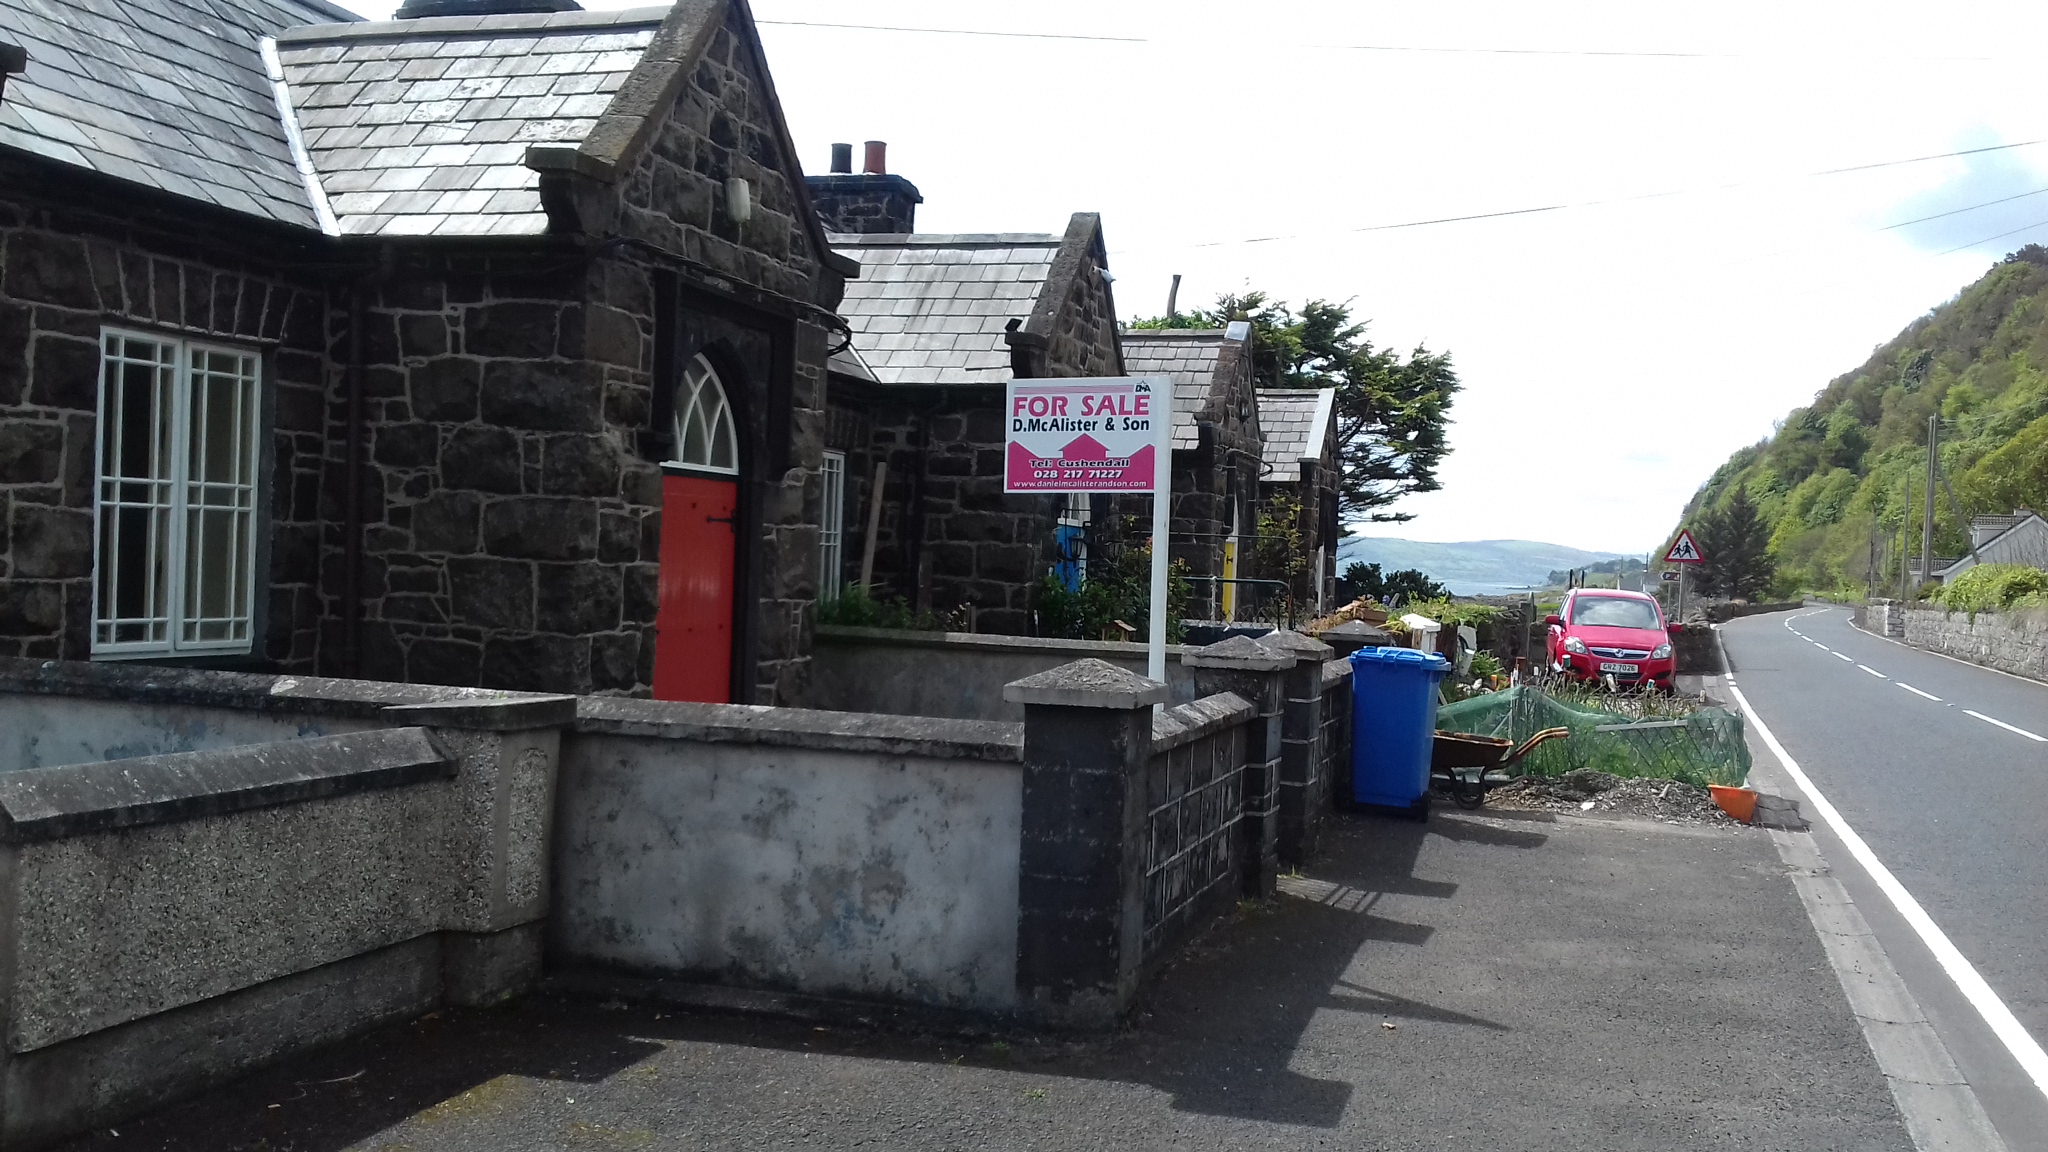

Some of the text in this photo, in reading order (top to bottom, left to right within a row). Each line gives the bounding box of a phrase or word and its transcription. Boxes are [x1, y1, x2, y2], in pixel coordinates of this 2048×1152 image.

[1013, 395, 1150, 417] FOR SALE
[1013, 417, 1149, 432] D.McAlister & Son
[1057, 459, 1129, 467] Cushendall
[1033, 470, 1123, 478] 028 217 71227
[1013, 480, 1147, 488] www.danielmcalisterandson.com
